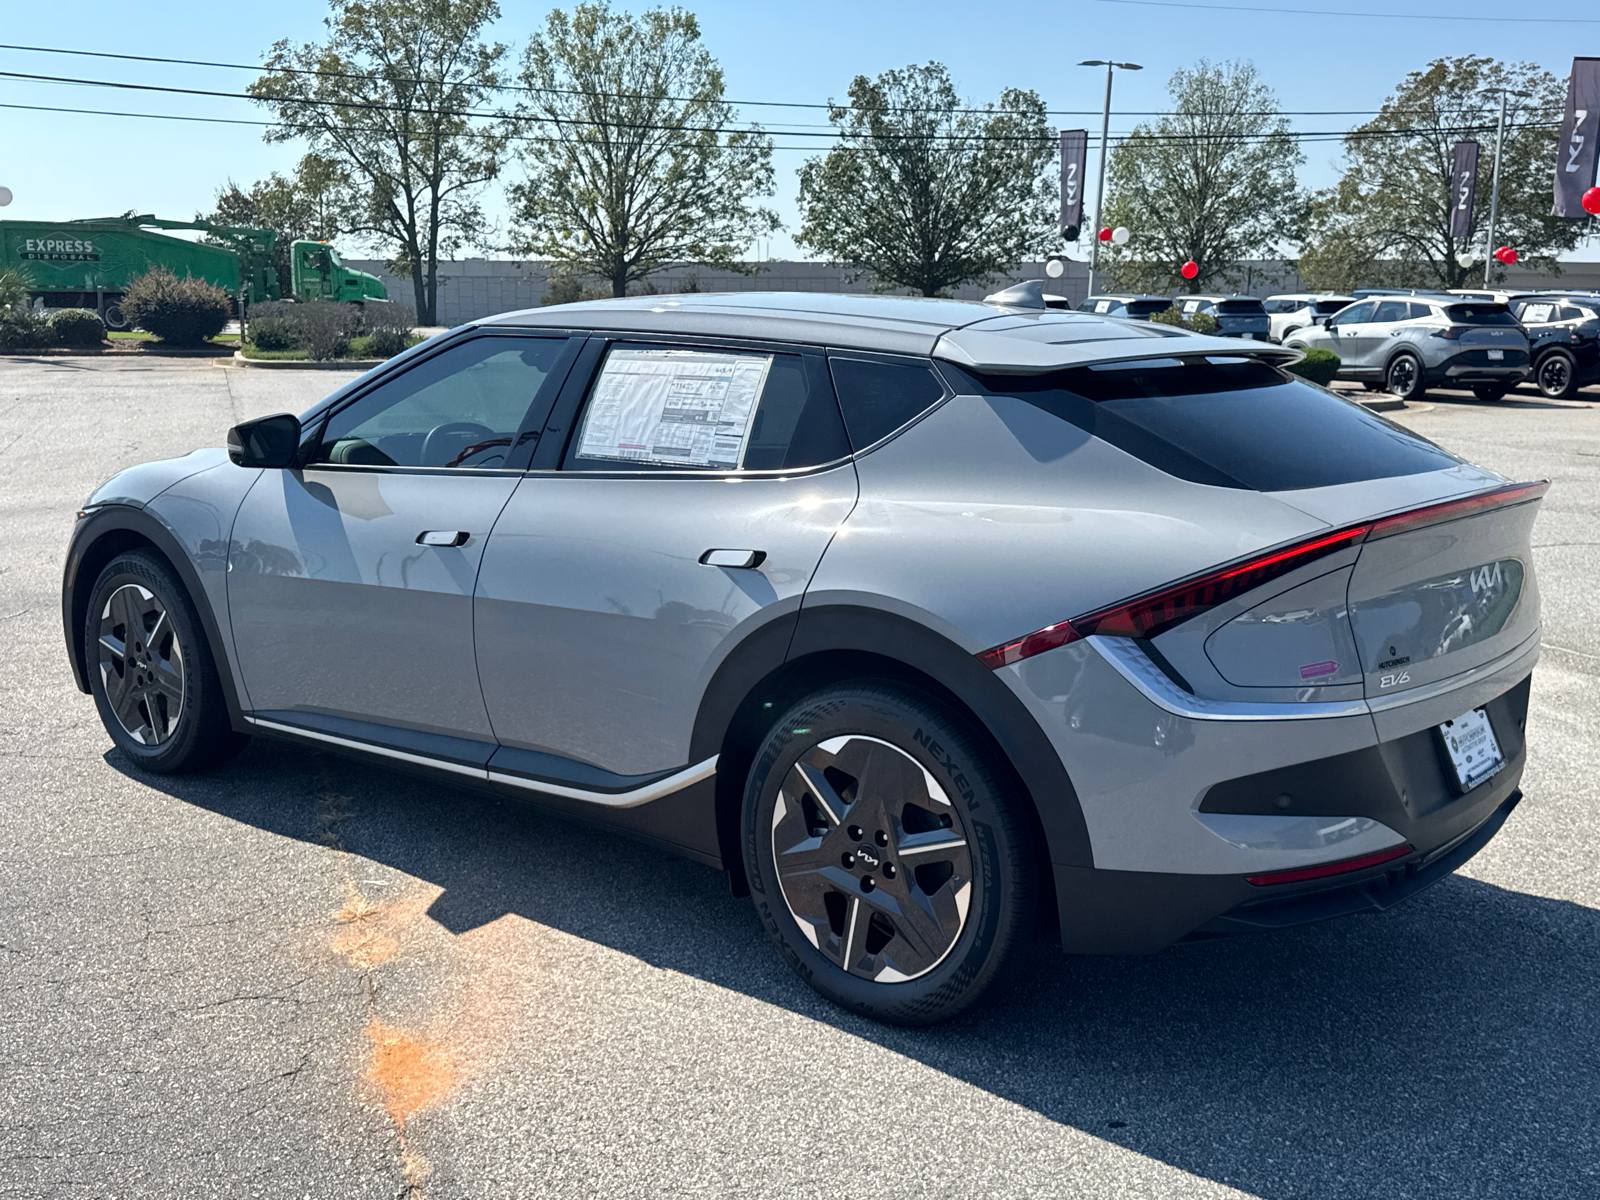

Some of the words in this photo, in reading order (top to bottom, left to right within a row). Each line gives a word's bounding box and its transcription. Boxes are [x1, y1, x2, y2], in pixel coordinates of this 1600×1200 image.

[26, 239, 93, 253] EXPRESS
[1470, 561, 1502, 594] KIA
[182, 644, 194, 710] NEXEN
[1378, 655, 1410, 670] HUTCHINSON
[1380, 671, 1410, 689] EV6
[912, 727, 981, 812] NEXEN
[975, 825, 992, 888] N'FERA
[759, 901, 814, 981] NEXEN
